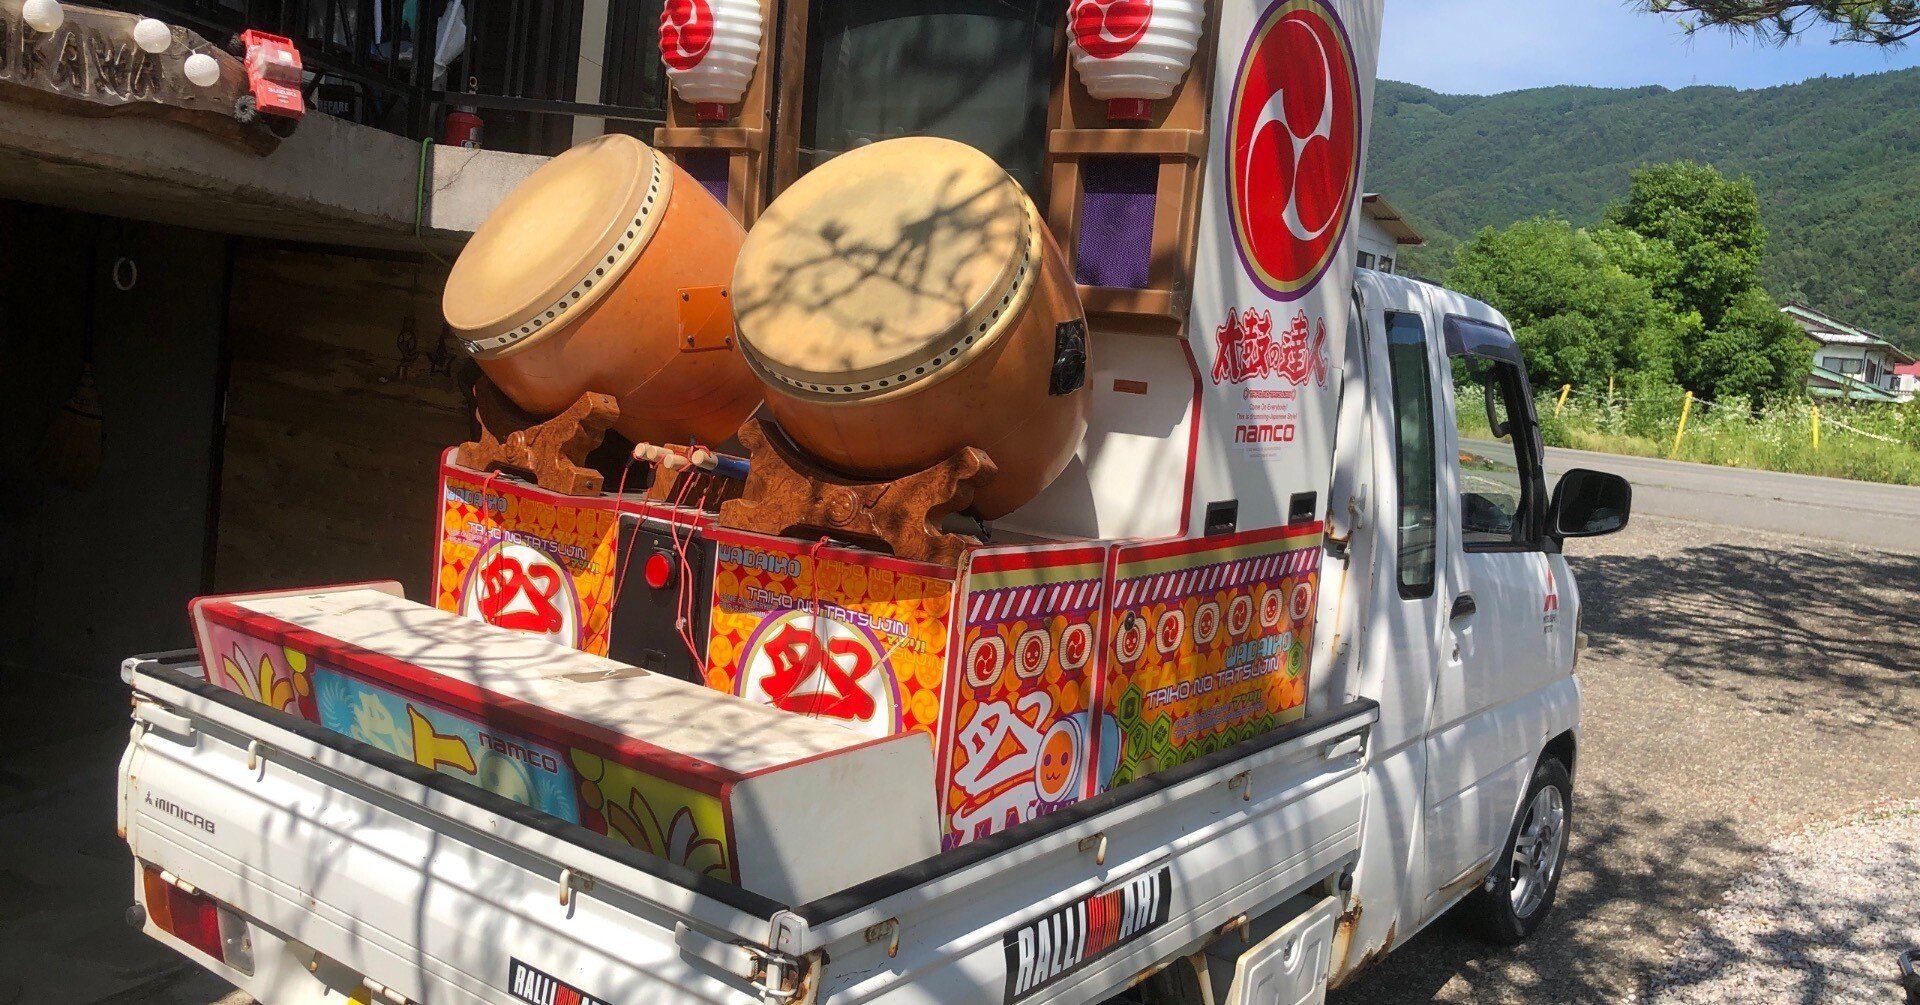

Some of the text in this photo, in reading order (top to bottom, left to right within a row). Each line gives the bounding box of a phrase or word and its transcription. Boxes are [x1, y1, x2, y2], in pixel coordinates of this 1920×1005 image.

[1211, 307, 1328, 388] 太鼓の達人
[1235, 424, 1295, 443] namco
[468, 521, 501, 540] TAIKO
[504, 530, 522, 543] NO
[523, 534, 587, 560] TATSUJIN
[718, 543, 801, 578] WADAIKO
[747, 586, 910, 637] TAIKO NO TATSUJIN
[1225, 631, 1293, 667] WADAIKO
[1146, 656, 1280, 710] TAIKO NO TATSUJIN
[478, 731, 559, 774] namco
[155, 797, 215, 834] MINICAB
